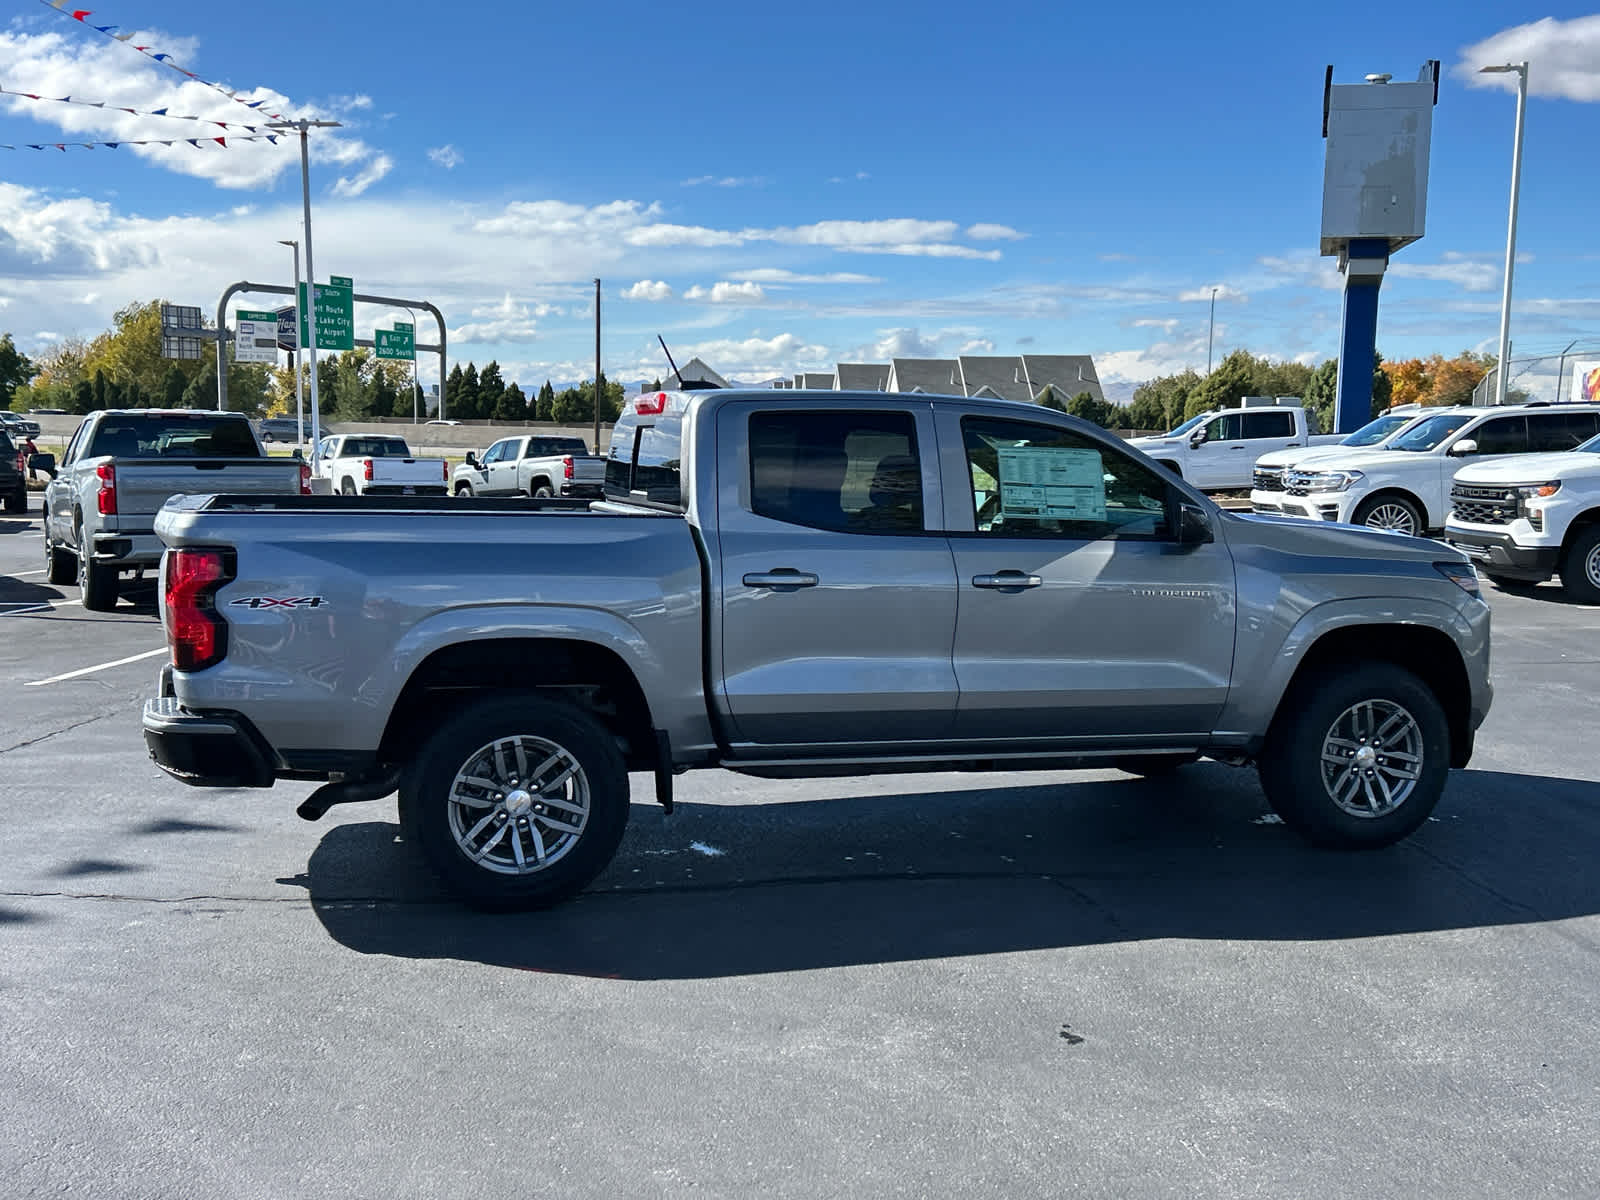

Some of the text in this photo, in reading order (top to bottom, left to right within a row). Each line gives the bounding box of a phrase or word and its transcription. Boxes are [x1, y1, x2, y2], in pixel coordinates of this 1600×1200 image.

[326, 305, 344, 315] Route
[320, 316, 335, 325] Lake
[337, 318, 350, 328] City
[323, 328, 346, 337] Airport
[378, 347, 413, 357] 2600 South
